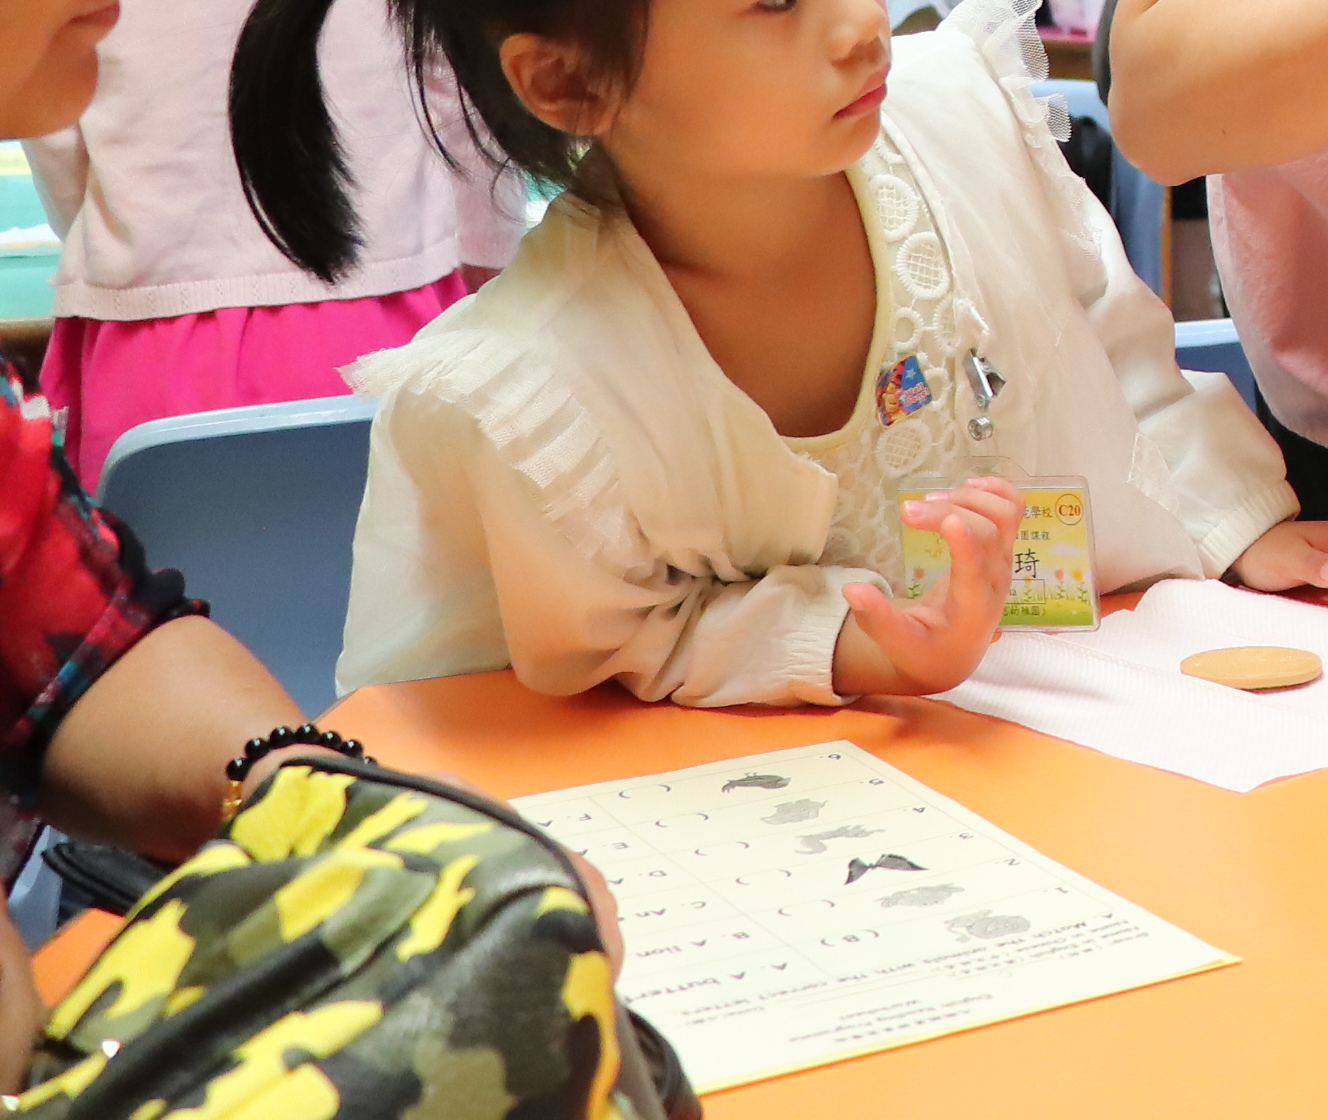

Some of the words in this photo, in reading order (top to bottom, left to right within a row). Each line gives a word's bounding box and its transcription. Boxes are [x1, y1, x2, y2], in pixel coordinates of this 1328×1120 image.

[904, 383, 925, 398] Well
[905, 389, 930, 406] Done!
[1058, 503, 1081, 517] C20
[1015, 531, 1050, 541] 園課程
[1015, 548, 1040, 578] 琦
[1032, 921, 1088, 939] Match
[997, 937, 1025, 947] the
[923, 946, 988, 964] animals
[876, 962, 914, 975] with
[837, 973, 868, 983] the
[758, 981, 828, 1001] correct
